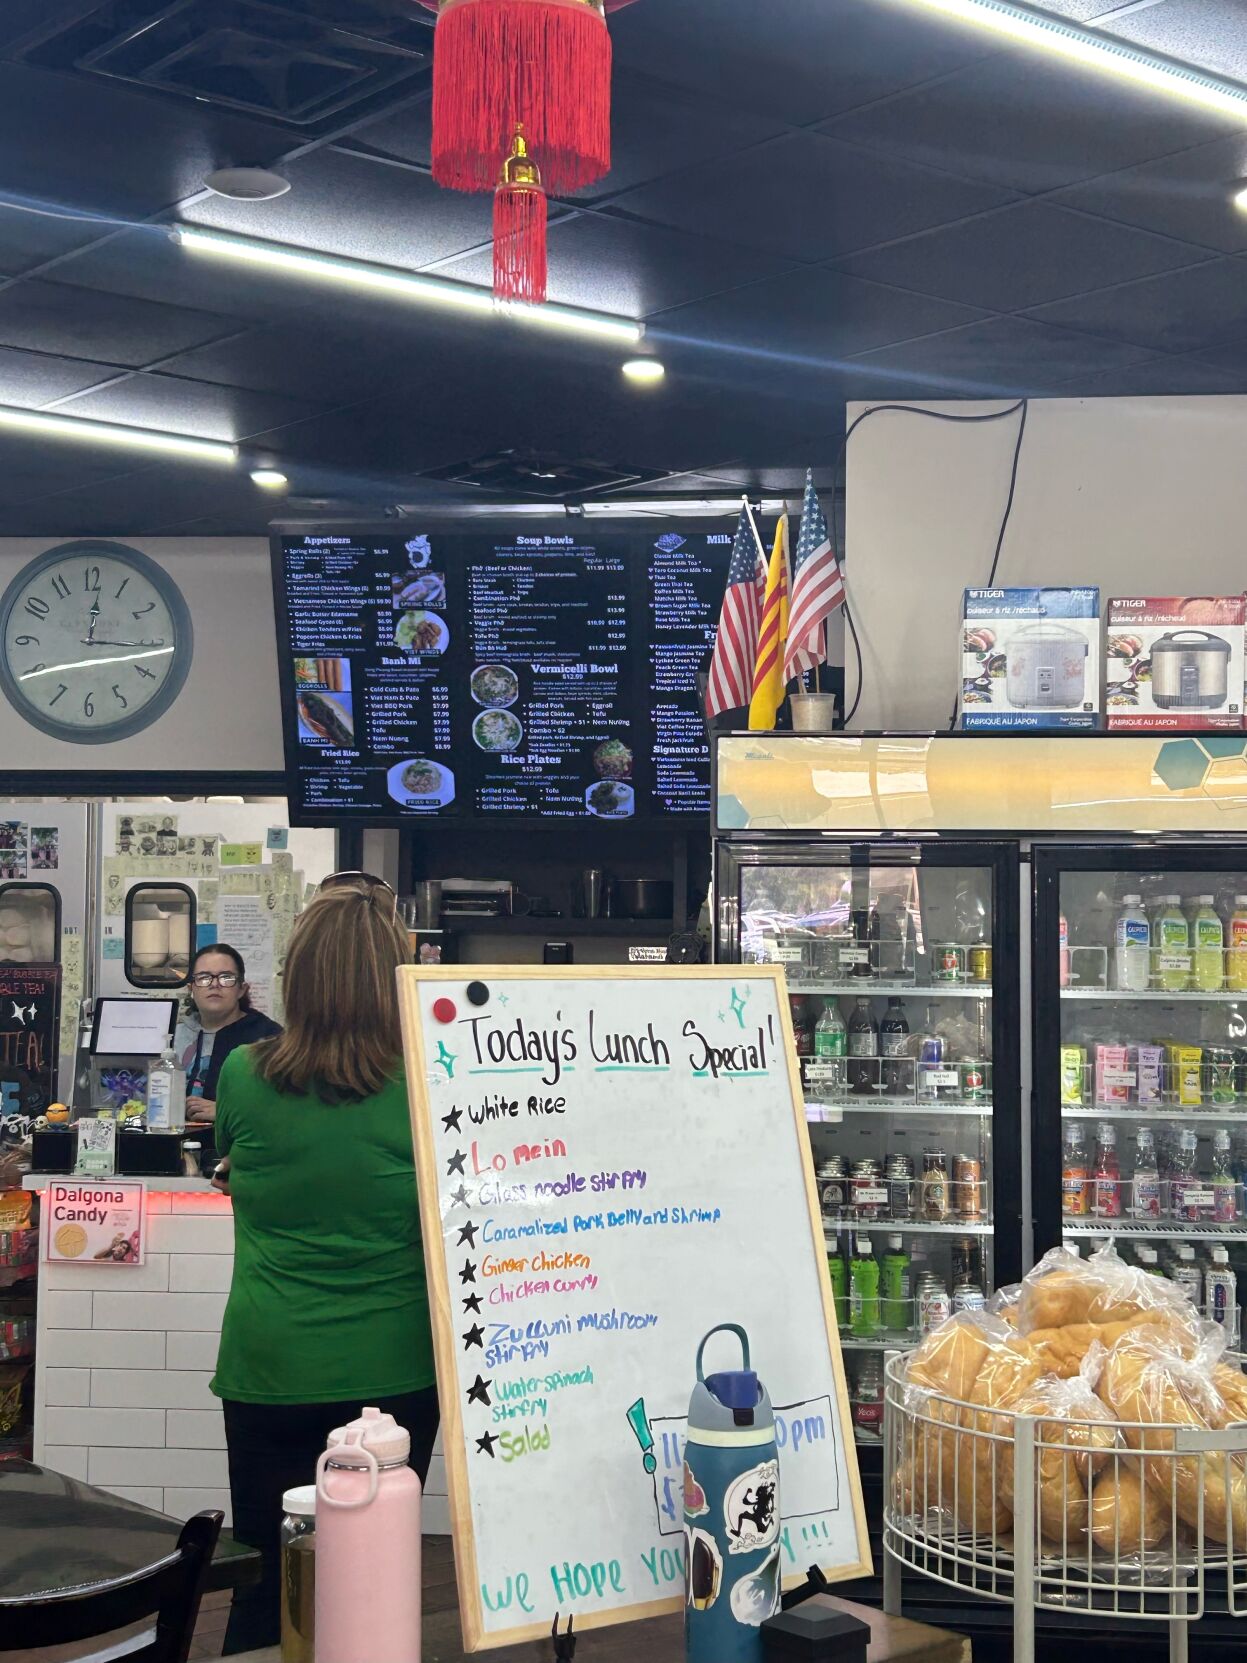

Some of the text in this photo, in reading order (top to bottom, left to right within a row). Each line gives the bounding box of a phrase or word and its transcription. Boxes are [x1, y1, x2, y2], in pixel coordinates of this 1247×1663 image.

[304, 536, 350, 545] Appetizers
[517, 536, 573, 545] Soup Bowls
[707, 535, 731, 544] Milk
[51, 574, 72, 600] 11
[84, 566, 101, 591] 12
[115, 578, 130, 598] 1
[979, 590, 1004, 598] TIGER
[24, 597, 50, 621] 10
[132, 602, 156, 620] 2
[1122, 599, 1146, 607] TIGER
[15, 635, 40, 646] 9
[134, 665, 156, 680] 4
[531, 664, 618, 673] Vermicelli Bowl
[49, 683, 68, 706] 7
[112, 684, 127, 708] 5
[84, 692, 94, 717] 6
[653, 745, 700, 754] Signature
[501, 755, 561, 764] Rice Plates
[458, 1010, 777, 1085] Today's Lunch Special!
[468, 1095, 566, 1125] White Rice
[472, 1141, 507, 1176] Lo
[55, 1188, 124, 1205] Dalgona
[478, 1183, 527, 1206] Glass
[534, 1172, 586, 1197] noodle
[54, 1206, 108, 1224] Candy
[671, 1207, 721, 1224] Shrimp
[482, 1255, 529, 1277] Ginger
[500, 1424, 551, 1462] Salad
